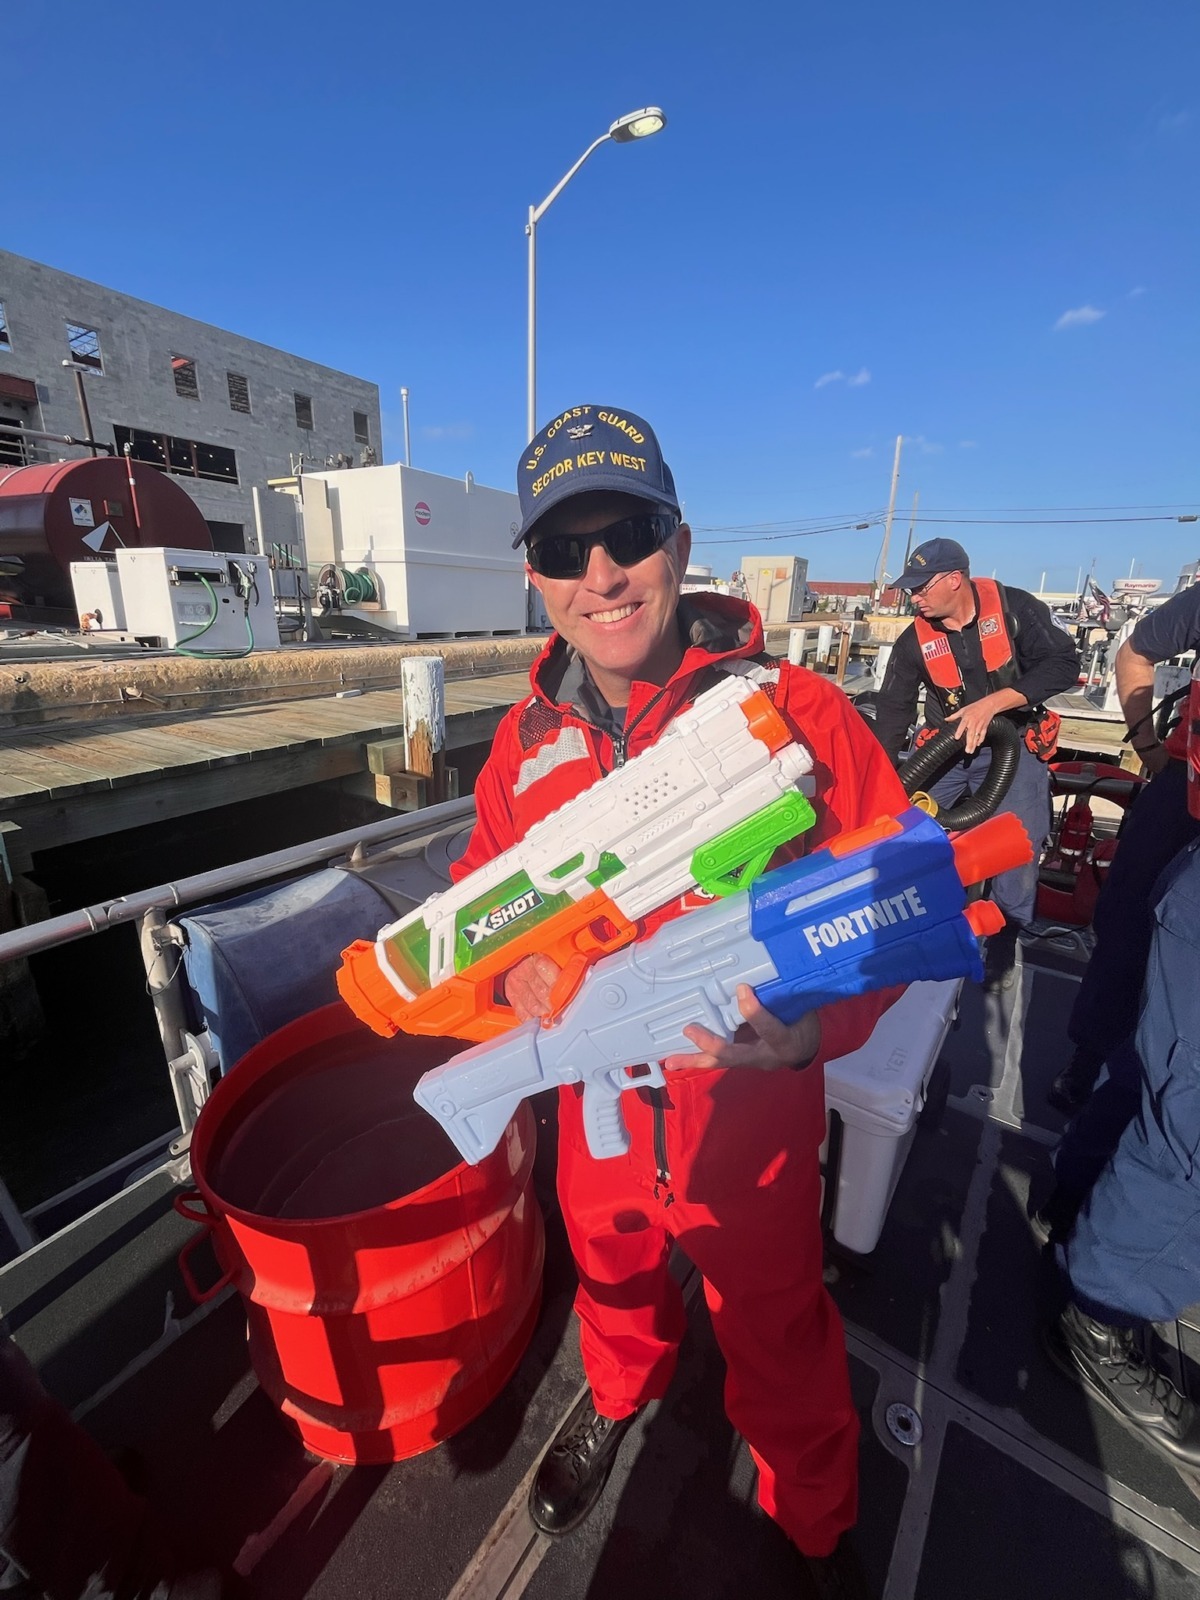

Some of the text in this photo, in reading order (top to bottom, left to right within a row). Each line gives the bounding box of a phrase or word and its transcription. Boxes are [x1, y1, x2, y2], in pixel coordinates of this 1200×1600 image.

[526, 406, 645, 470] U.S. COAST GUARD
[532, 451, 646, 497] SECTOR KEY WEST
[803, 886, 927, 957] FORTNITE
[884, 1047, 908, 1072] YETI
